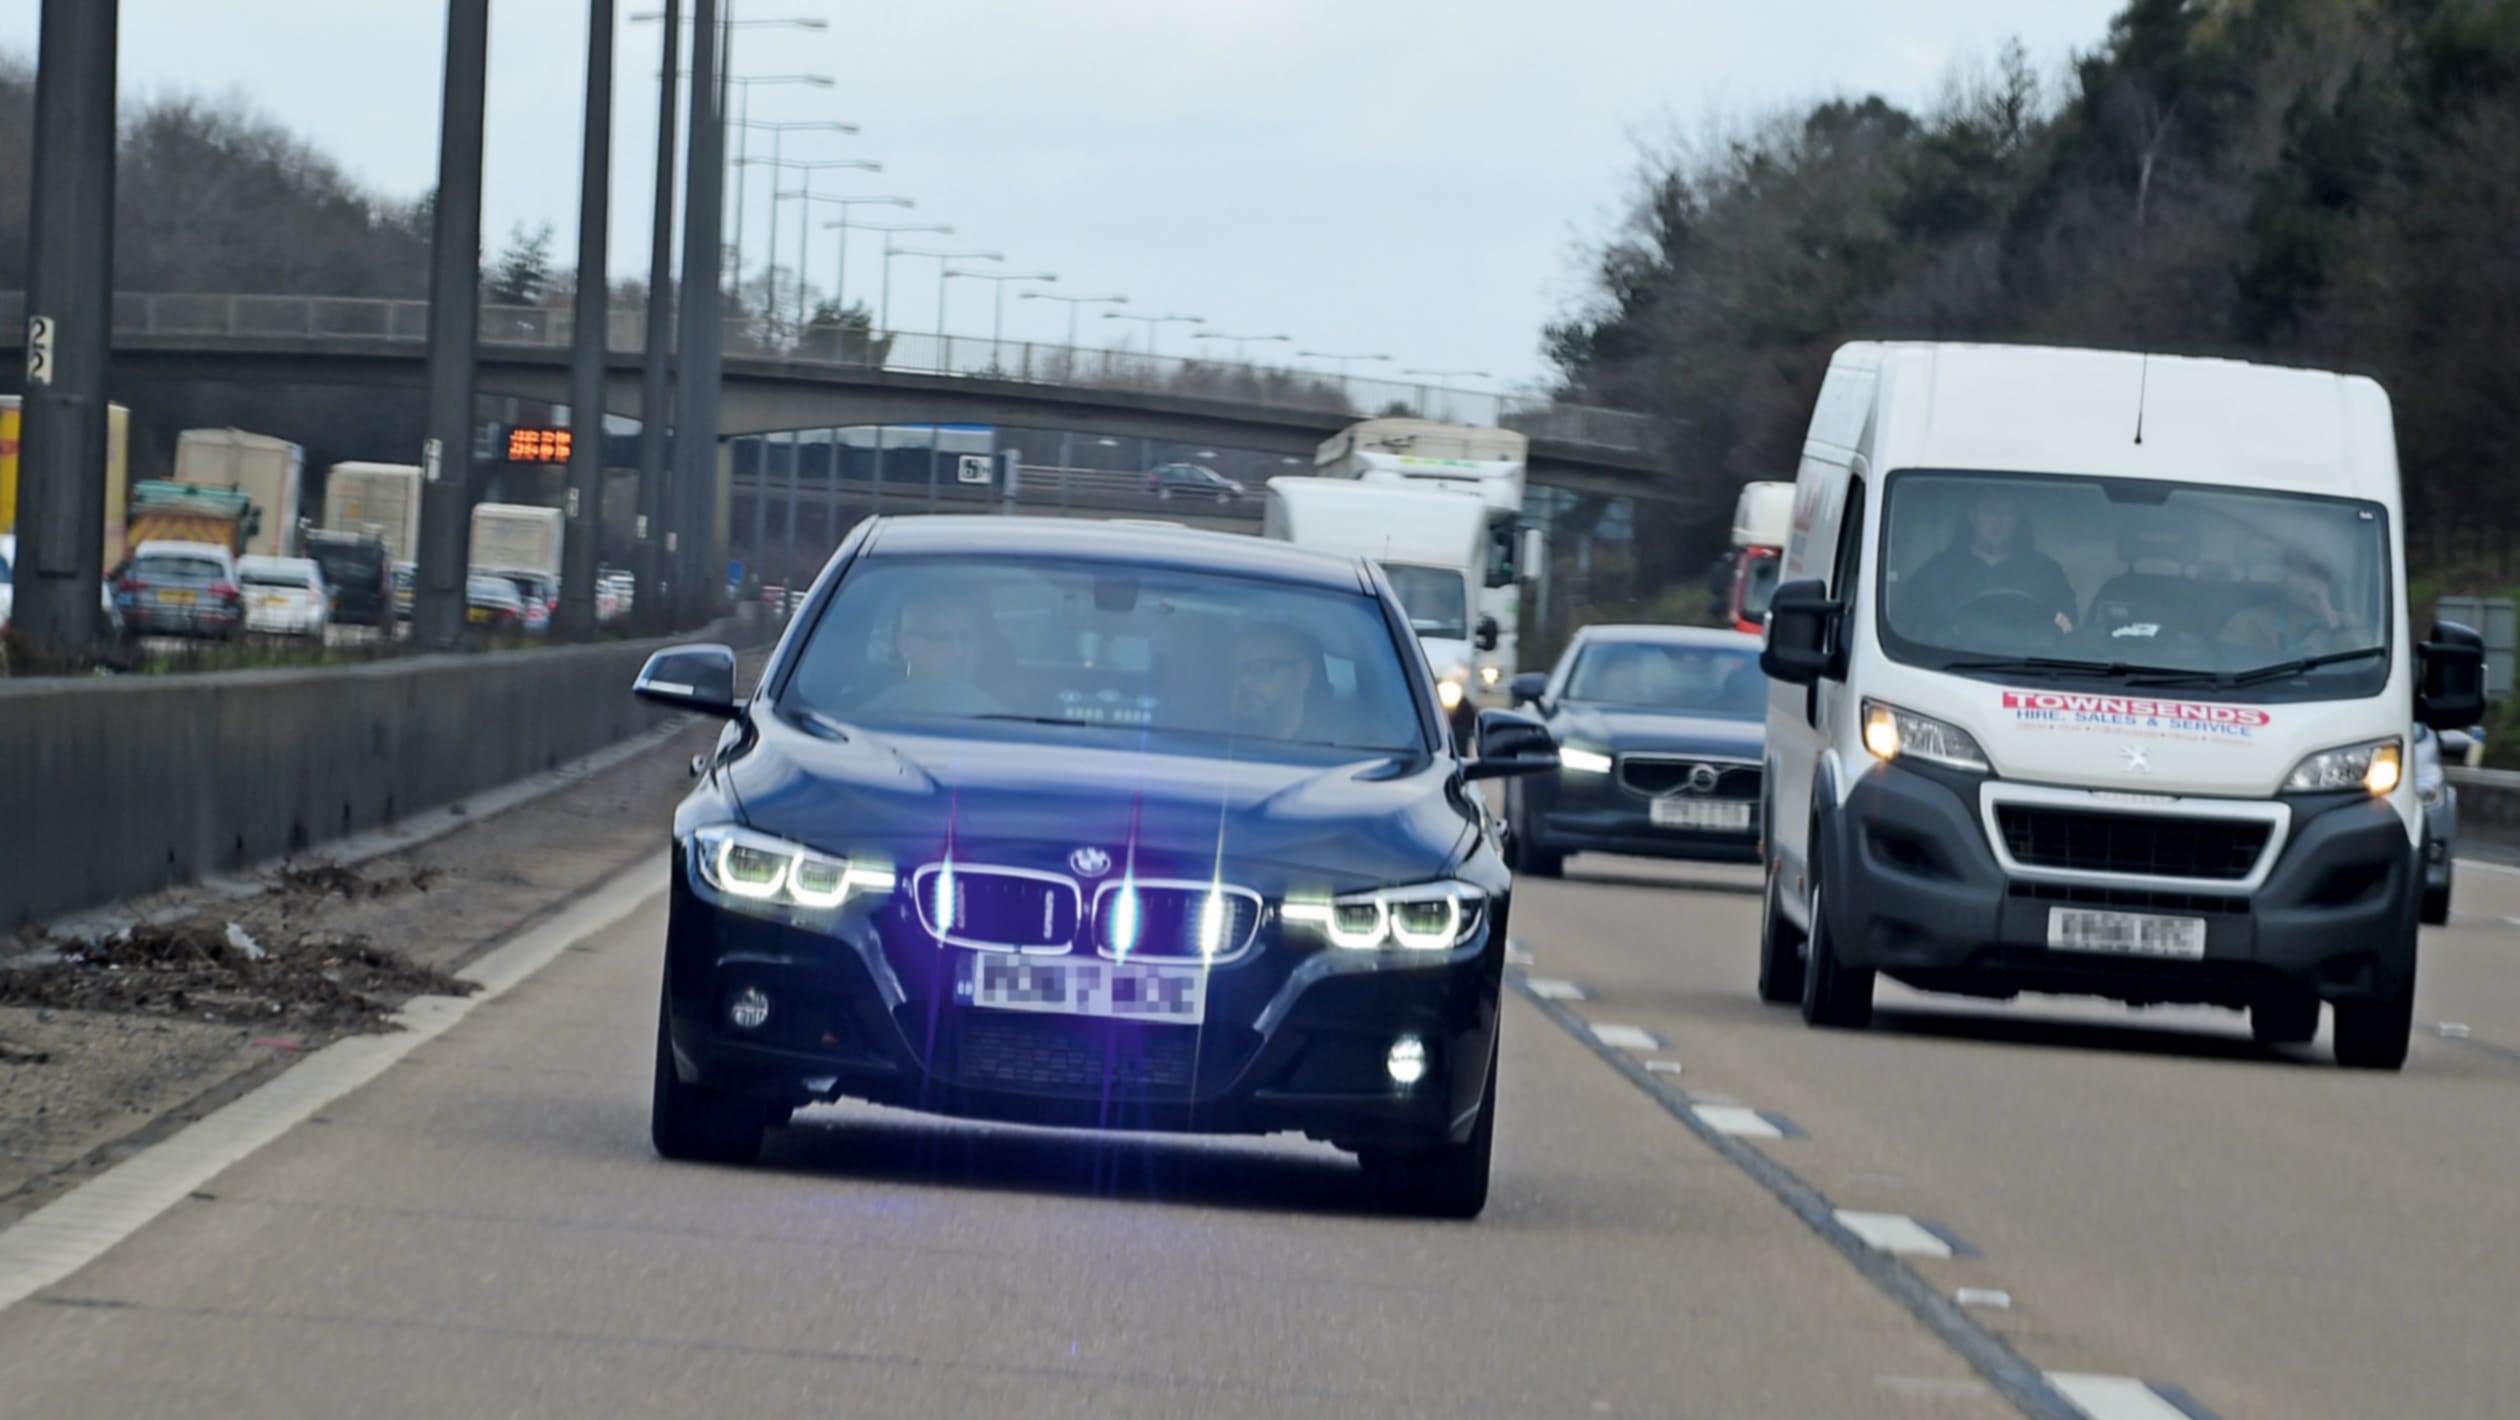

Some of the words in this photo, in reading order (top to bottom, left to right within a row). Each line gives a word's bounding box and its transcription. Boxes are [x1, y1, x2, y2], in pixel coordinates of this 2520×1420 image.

[2006, 692, 2262, 725] TOWNSENDS
[2075, 712, 2136, 725] SALES
[2169, 719, 2251, 737] SERVICE
